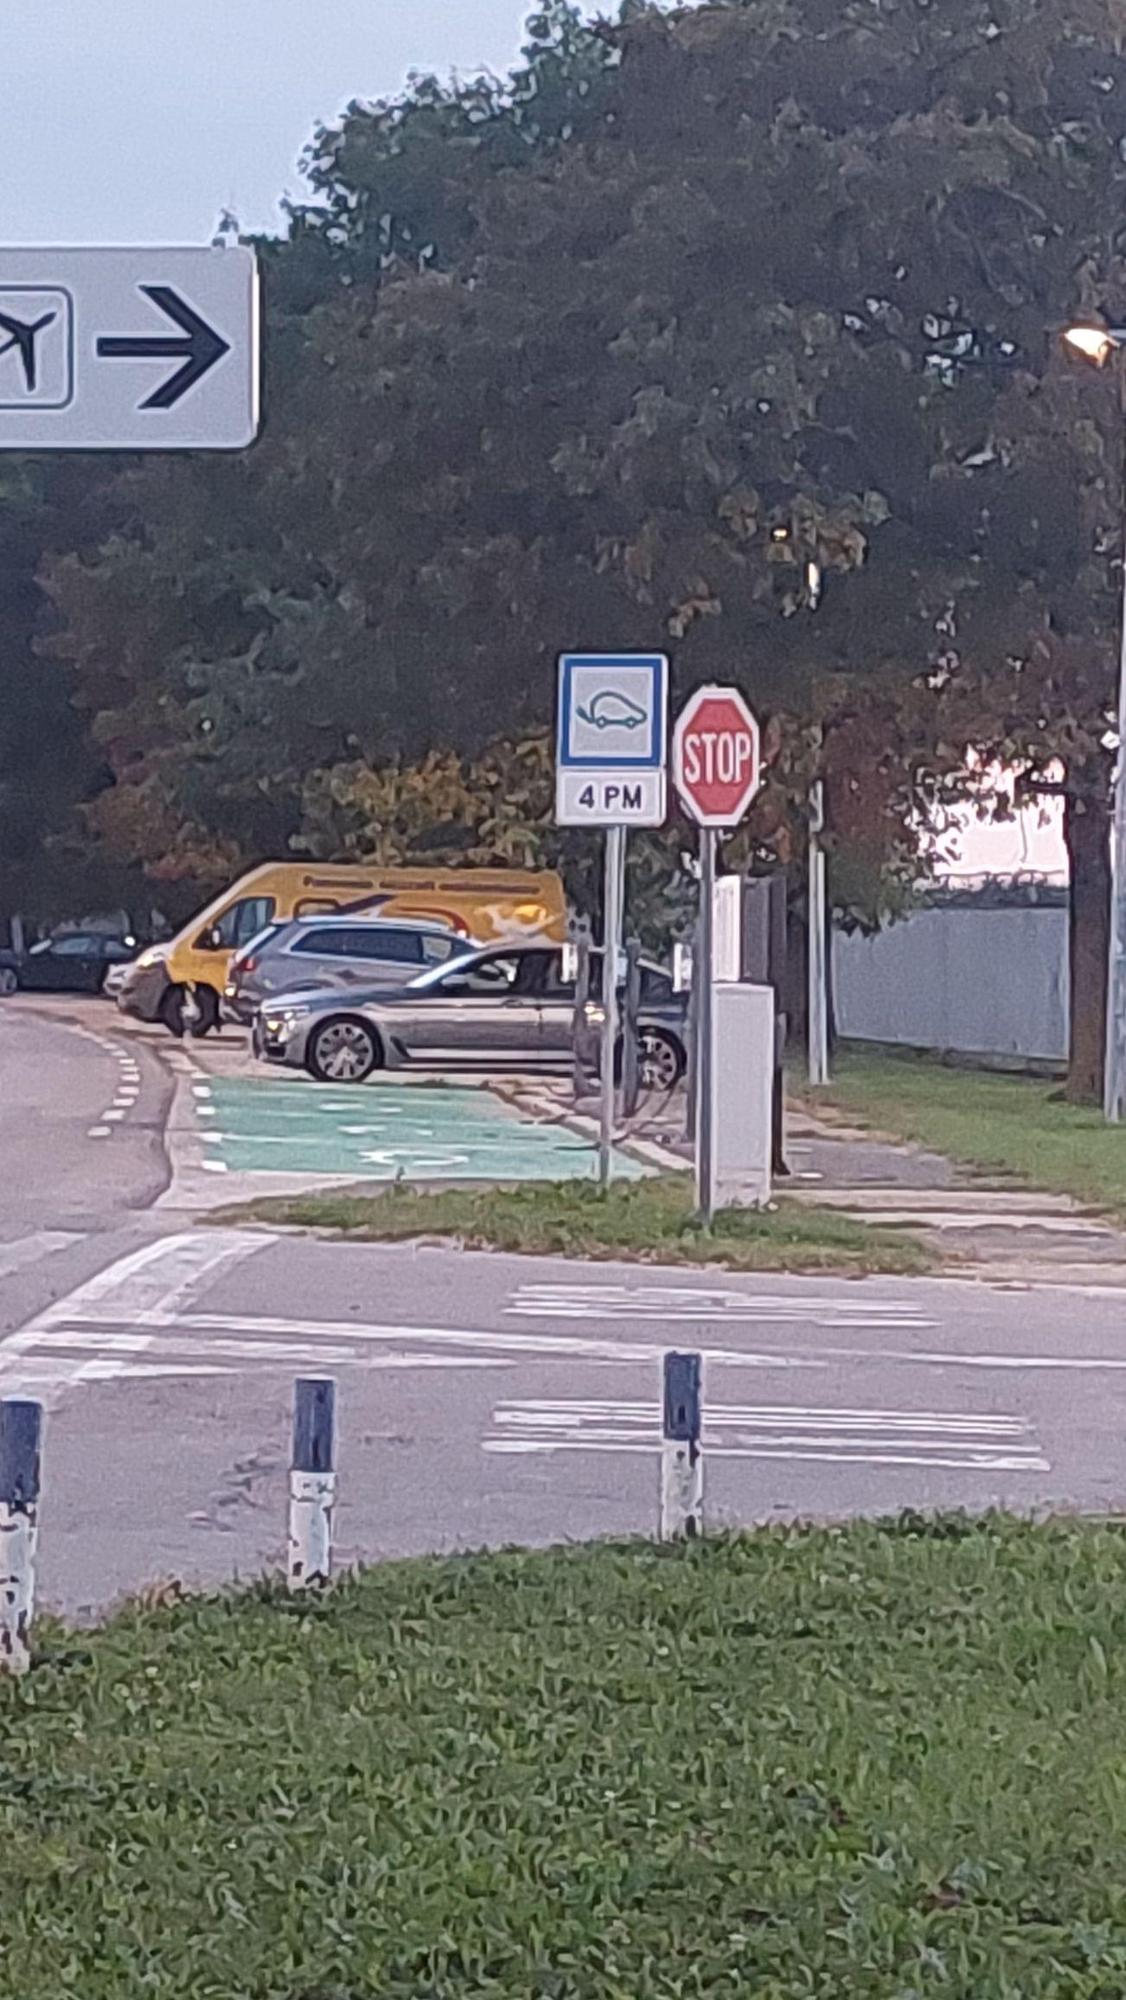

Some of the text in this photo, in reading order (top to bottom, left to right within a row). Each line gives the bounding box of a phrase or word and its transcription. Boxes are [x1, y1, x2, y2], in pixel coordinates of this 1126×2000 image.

[684, 732, 750, 784] STOP
[578, 784, 642, 810] 4 PM
